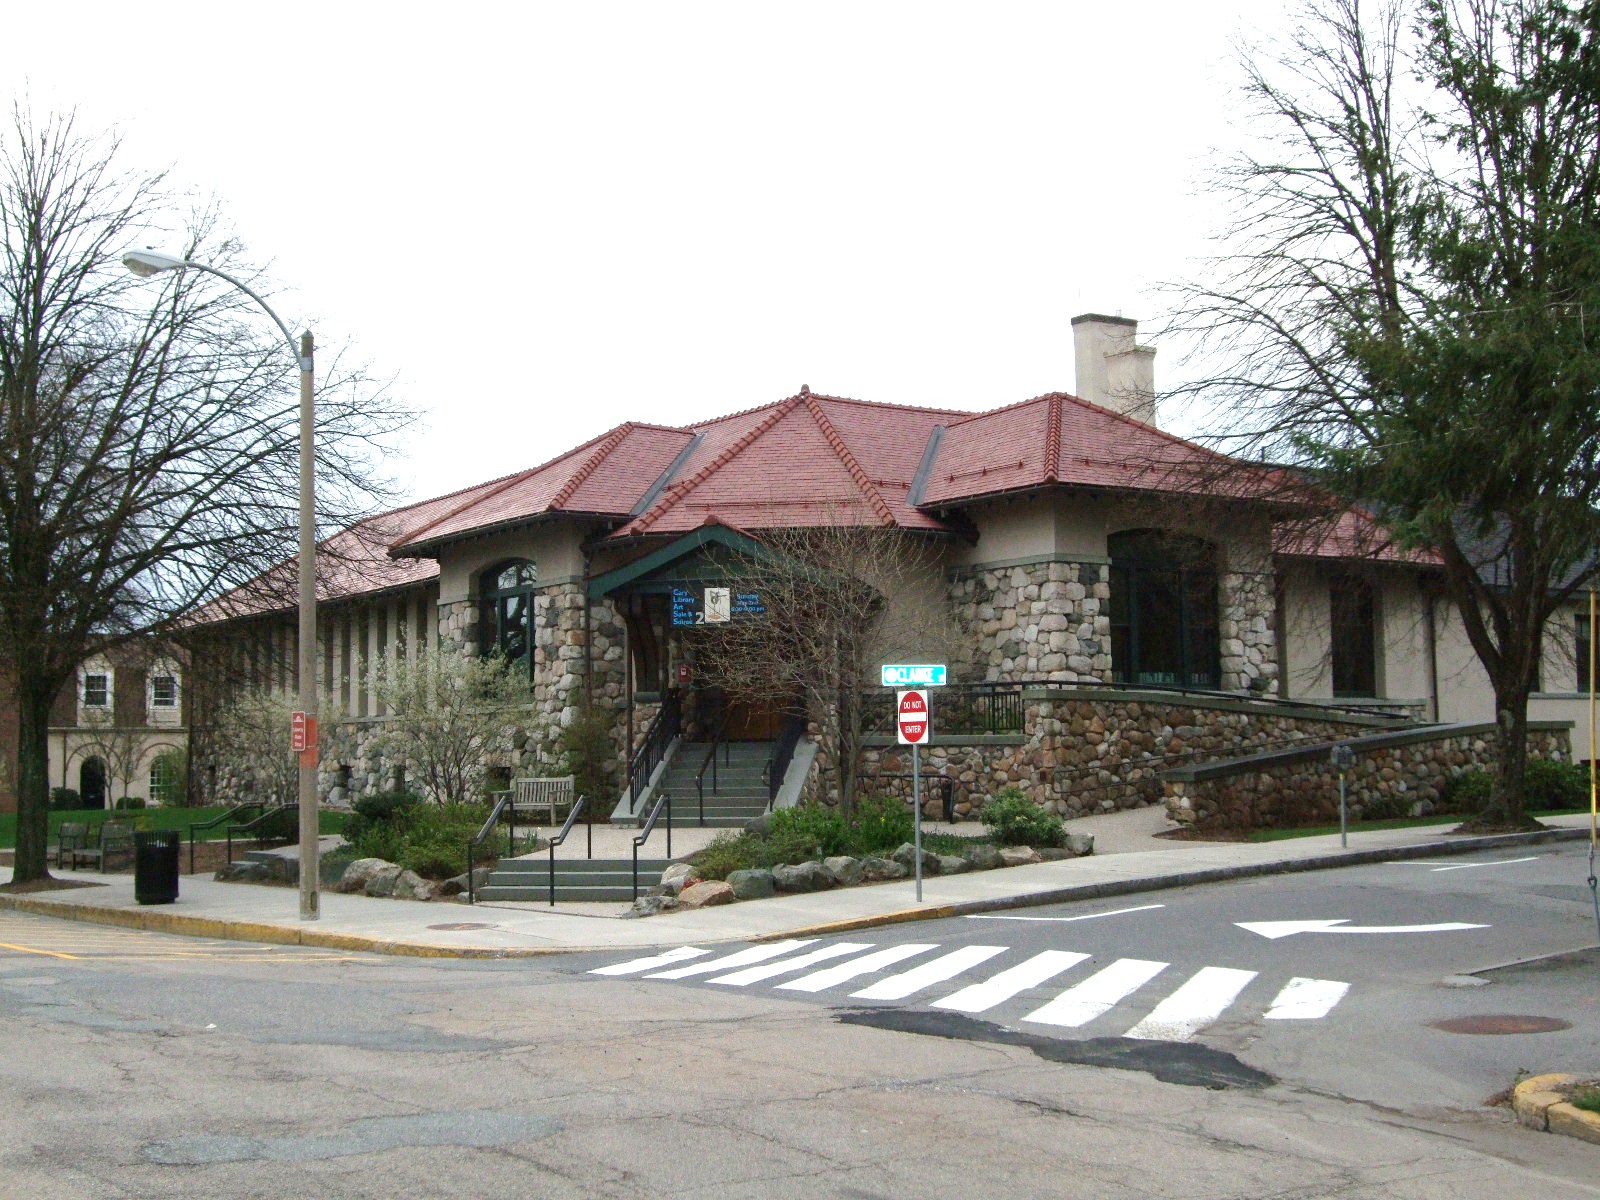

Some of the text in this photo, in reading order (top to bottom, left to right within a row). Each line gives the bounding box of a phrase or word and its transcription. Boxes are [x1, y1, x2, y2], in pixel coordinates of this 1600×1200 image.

[695, 611, 705, 625] 2
[897, 667, 935, 683] CLARKE
[903, 700, 922, 710] DO NOT
[905, 725, 922, 734] ENTER
